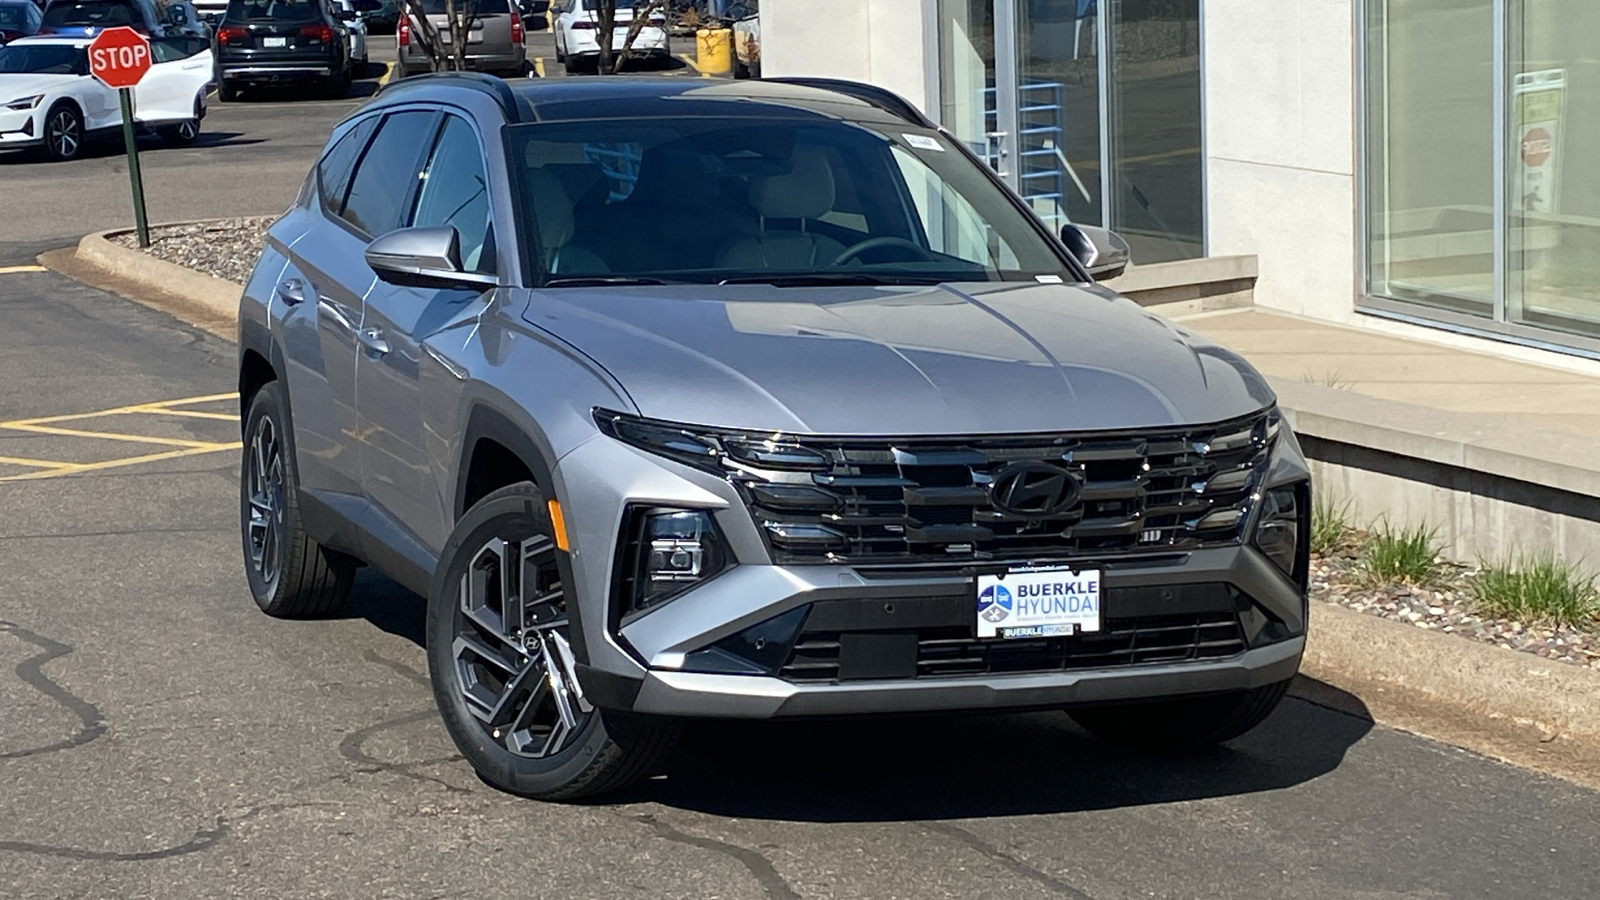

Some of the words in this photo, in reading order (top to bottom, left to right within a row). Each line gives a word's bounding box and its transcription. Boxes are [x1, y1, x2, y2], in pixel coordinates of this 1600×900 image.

[93, 44, 147, 71] STOP
[1017, 581, 1098, 598] BUERKLE
[1017, 595, 1098, 616] HYUNDAI
